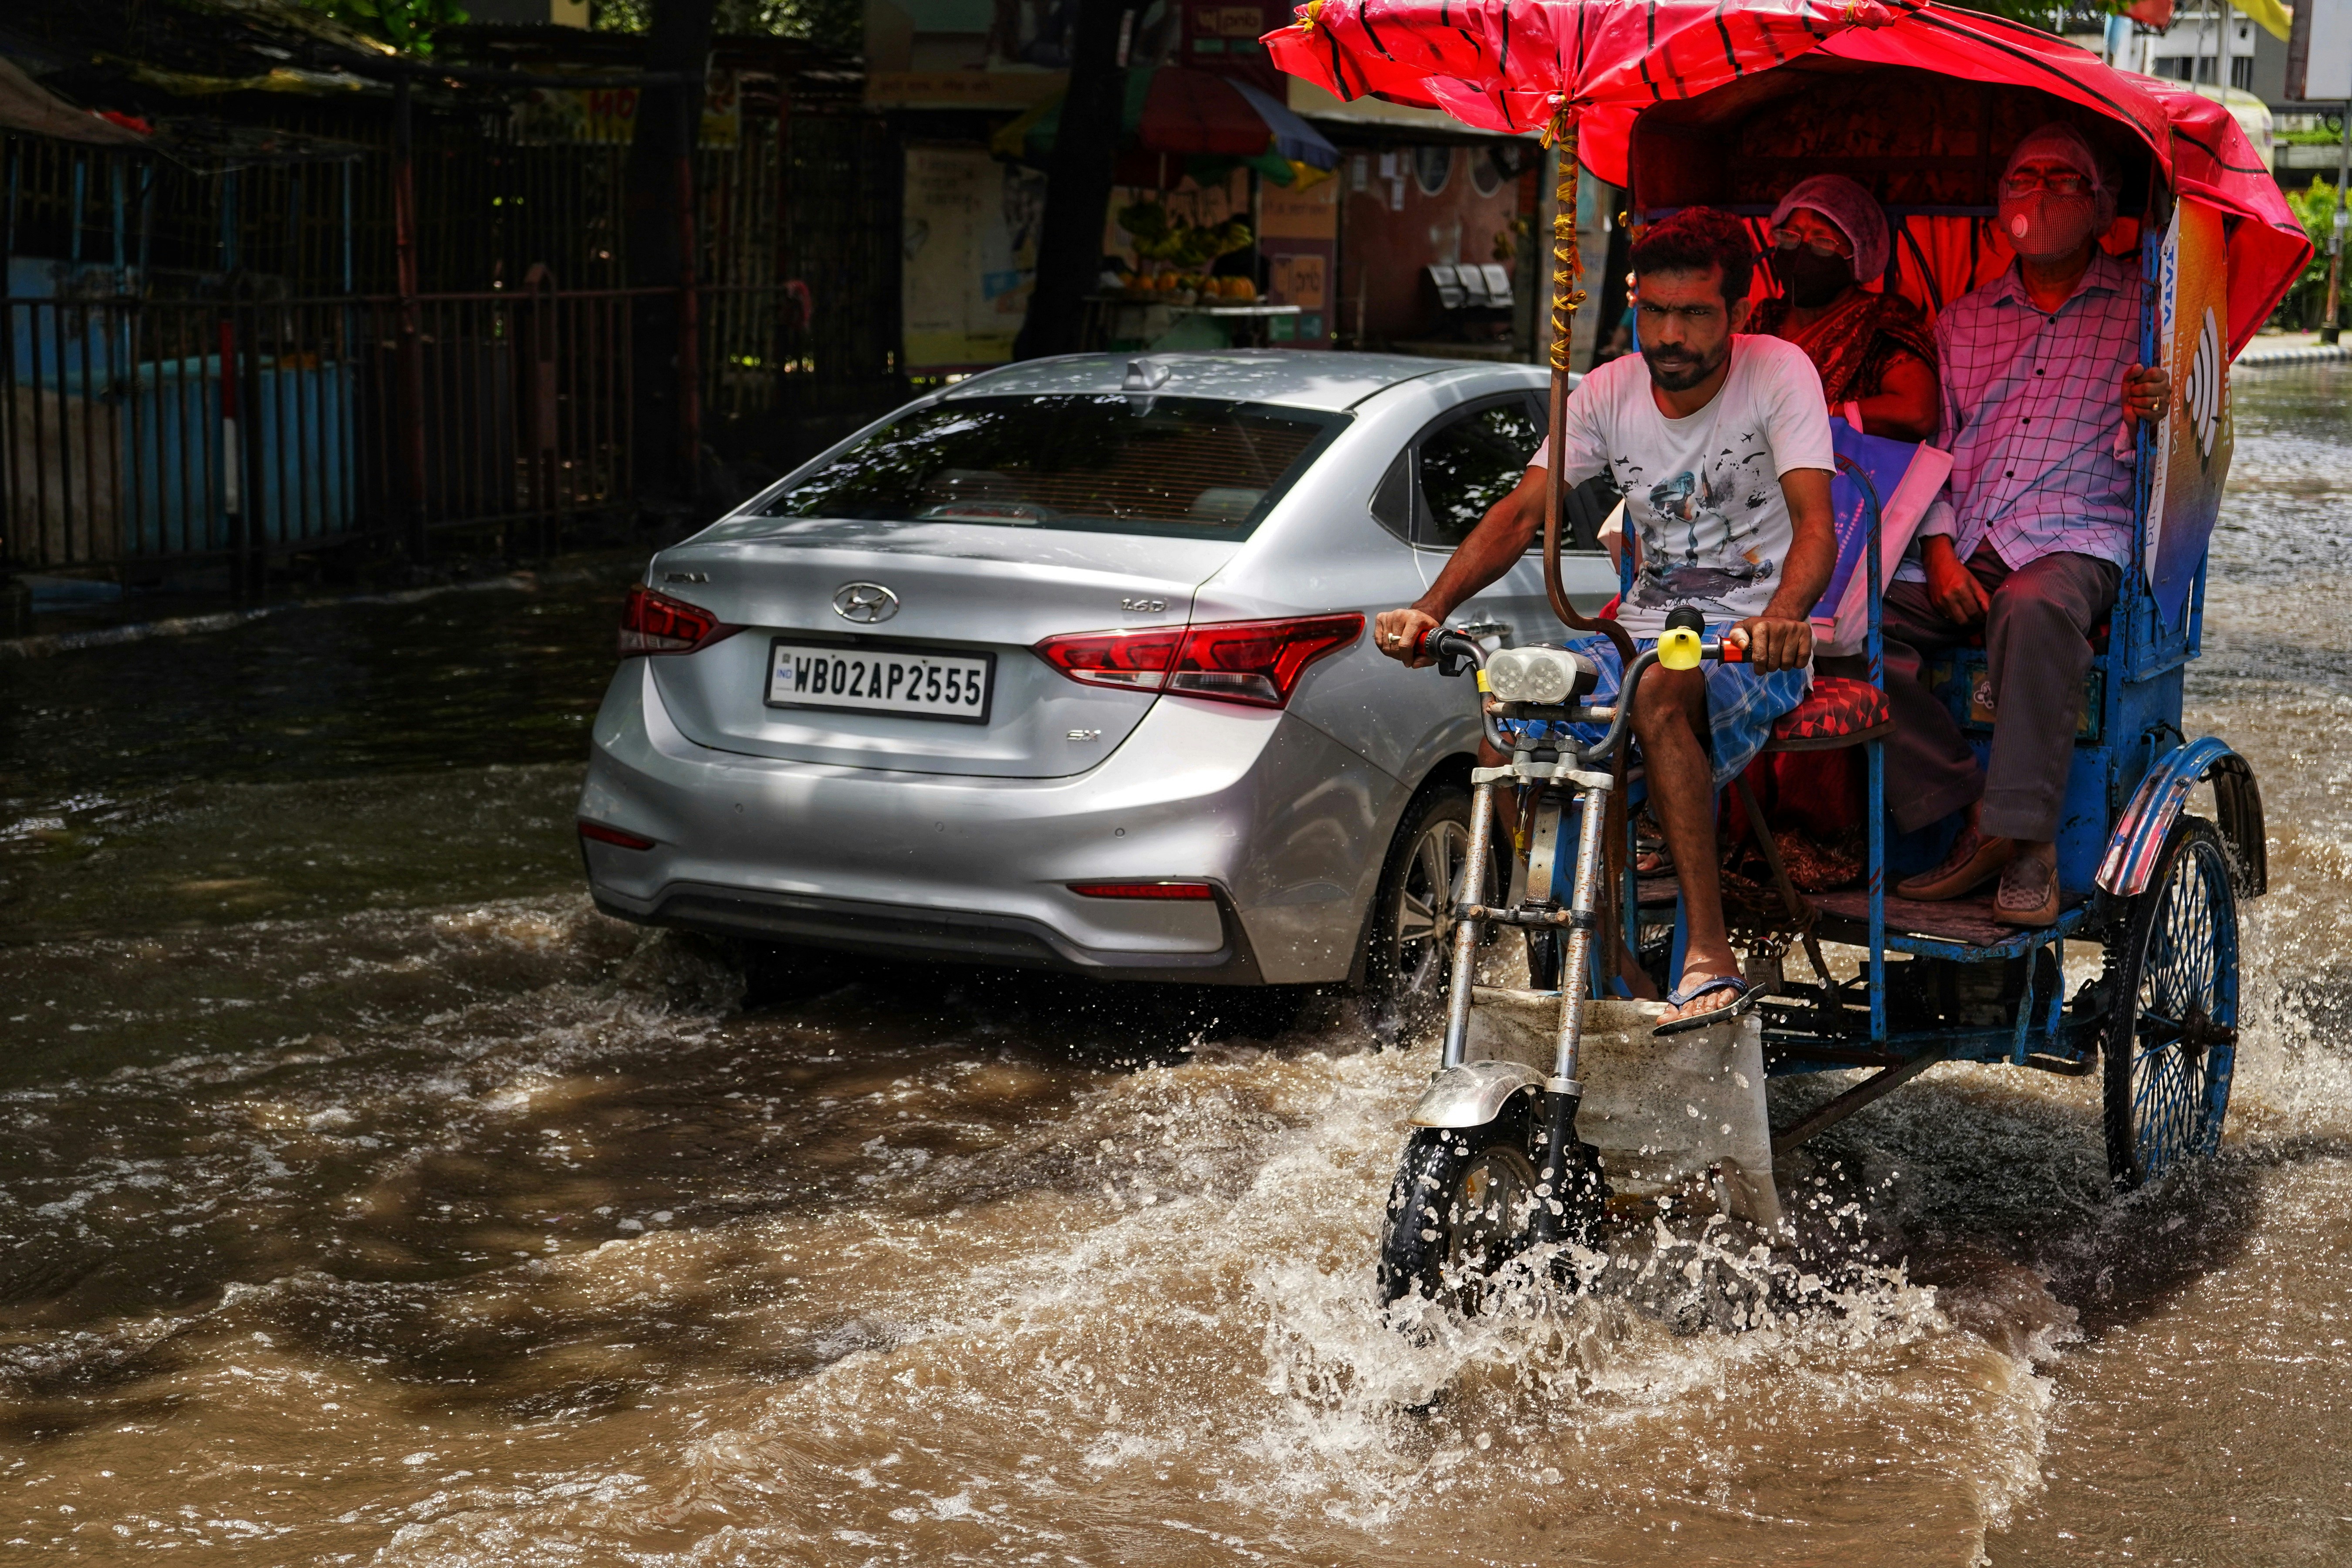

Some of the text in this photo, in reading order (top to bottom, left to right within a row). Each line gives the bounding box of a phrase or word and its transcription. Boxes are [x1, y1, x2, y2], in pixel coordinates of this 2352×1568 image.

[2164, 246, 2174, 327] TATA
[2163, 342, 2171, 372] sk
[2174, 331, 2183, 424] Upgrade
[776, 657, 980, 705] IND WB02AP2555
